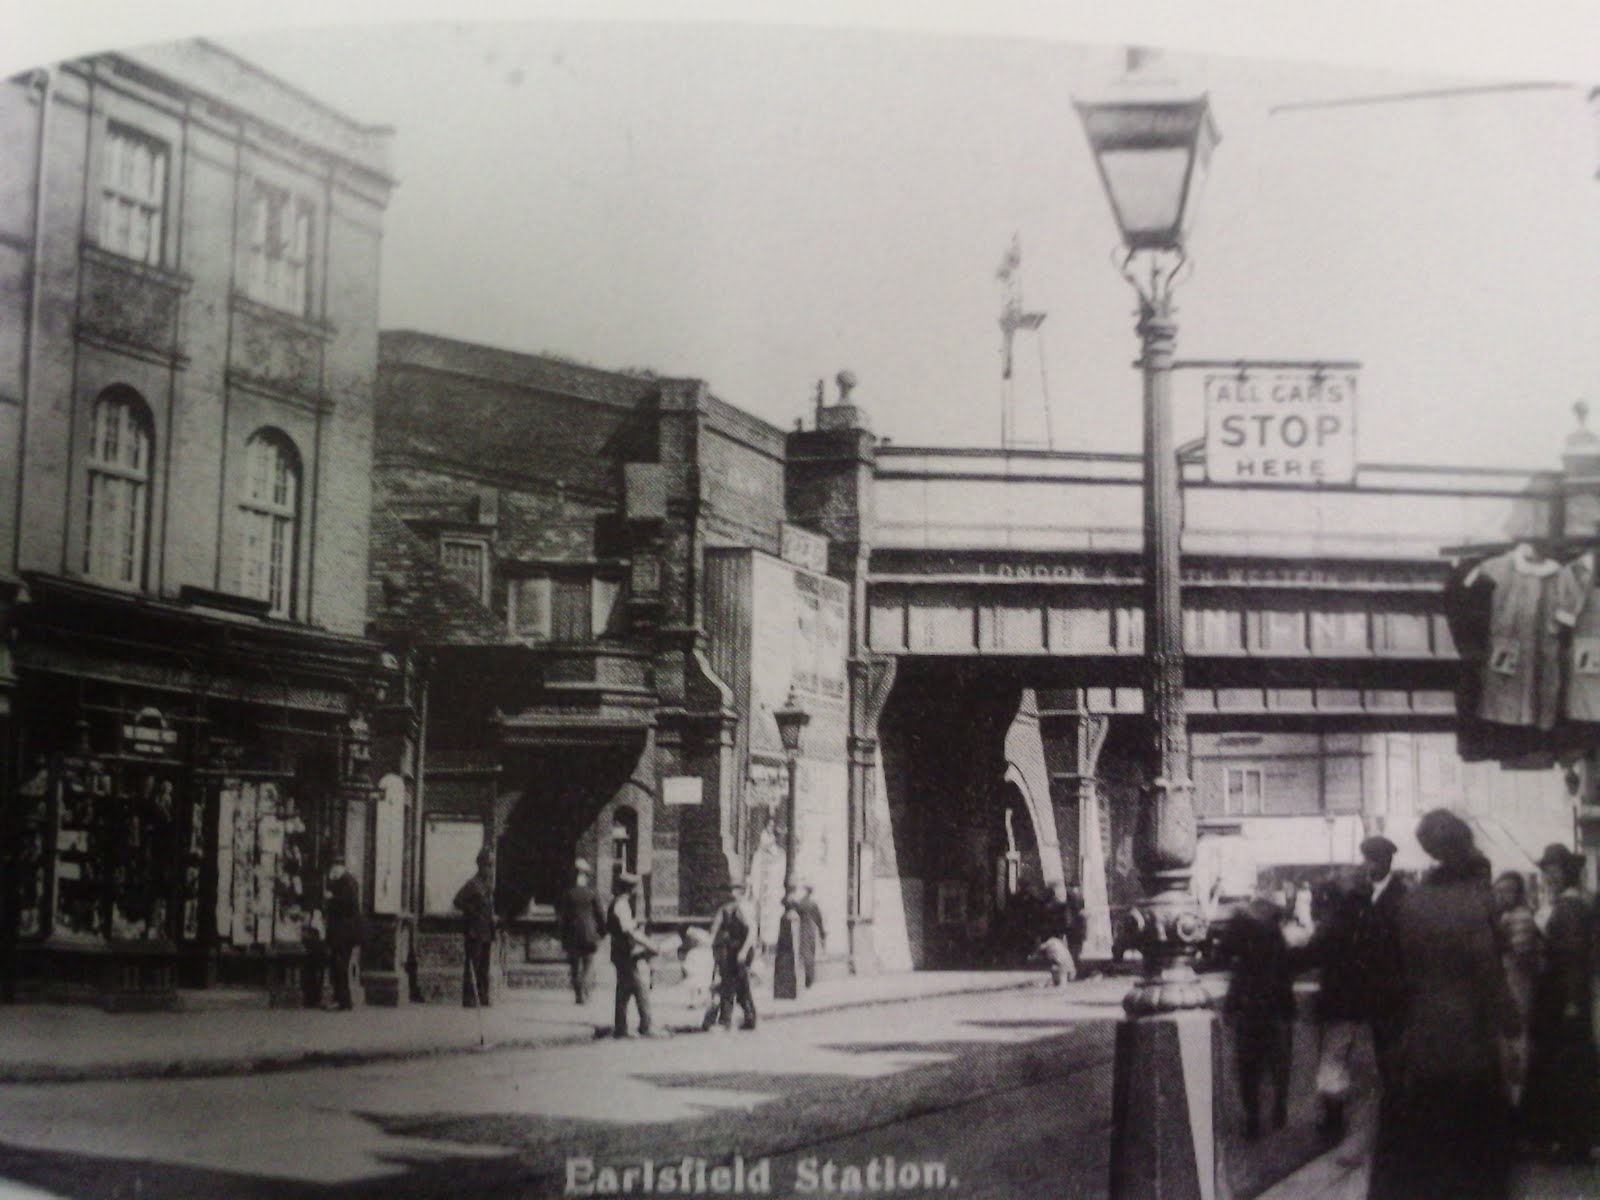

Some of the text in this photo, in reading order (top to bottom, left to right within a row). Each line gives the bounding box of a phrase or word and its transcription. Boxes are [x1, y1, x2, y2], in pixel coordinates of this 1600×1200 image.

[1216, 384, 1343, 402] ALL CARS
[1220, 414, 1341, 447] STOP
[1236, 459, 1326, 477] HERE
[978, 563, 1086, 581] LONDON
